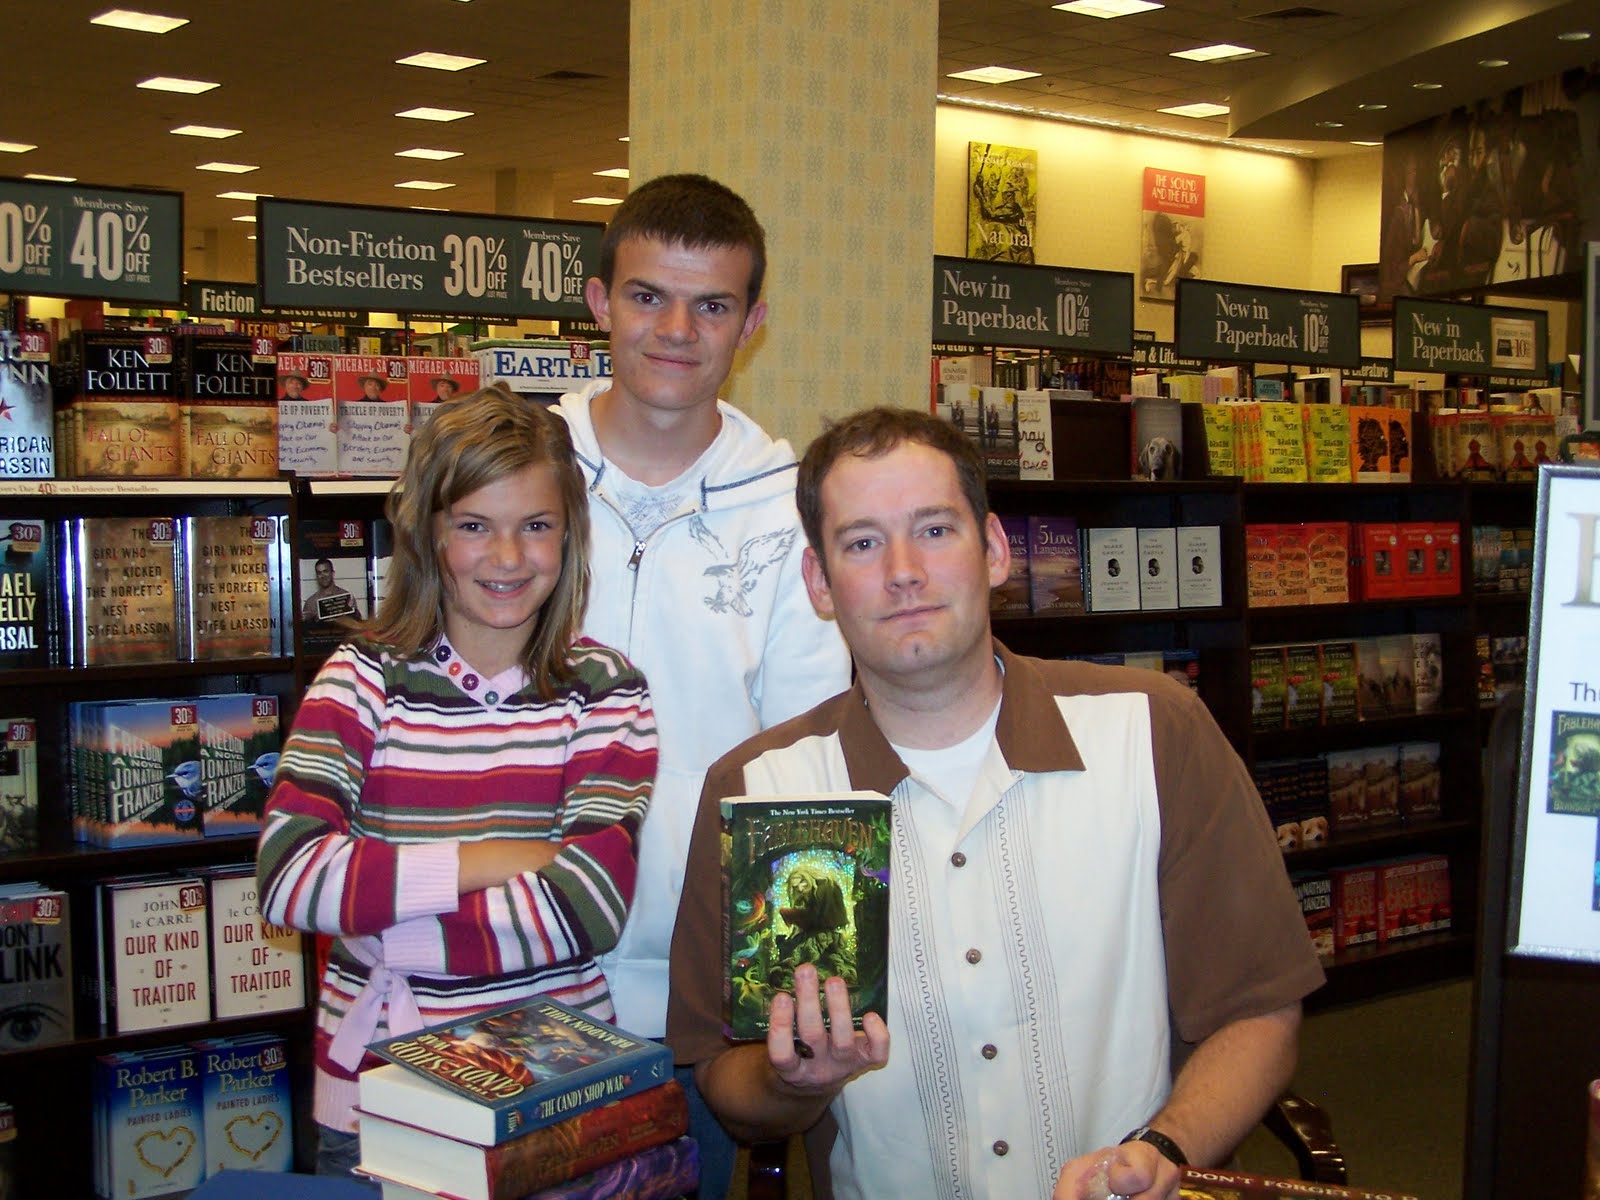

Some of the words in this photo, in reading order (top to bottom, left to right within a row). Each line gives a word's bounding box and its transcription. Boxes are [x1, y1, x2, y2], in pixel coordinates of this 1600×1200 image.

[1170, 176, 1196, 192] SOUND
[73, 196, 122, 211] Members
[124, 201, 150, 214] Save
[70, 210, 151, 281] 40%
[286, 226, 437, 263] Non-Fiction
[522, 229, 561, 241] Members
[562, 232, 581, 243] Save
[25, 243, 52, 266] OFF
[124, 251, 151, 274] OFF
[443, 234, 508, 298] 30%
[286, 257, 424, 292] Bestsellers
[486, 271, 508, 291] OFF
[521, 241, 583, 303] 40%
[563, 276, 583, 295] OFF
[942, 269, 989, 298] New
[990, 275, 1012, 300] in
[201, 287, 255, 314] Fiction
[1215, 293, 1250, 319] New
[1252, 298, 1270, 320] in
[942, 299, 1050, 337] Paperback
[1076, 318, 1090, 332] OFF
[1412, 312, 1442, 336] New
[1445, 316, 1461, 338] in
[1215, 320, 1299, 354] Paperback
[108, 348, 150, 369] KEN
[215, 352, 256, 373] KEN
[1412, 336, 1486, 368] Paperback
[335, 359, 375, 373] MICHAEL
[408, 359, 448, 374] MICHAEL
[449, 360, 480, 376] SAVAGE
[493, 350, 592, 379] EARTH
[87, 369, 172, 391] FOLLETT
[194, 373, 274, 395] FOLLETT
[301, 405, 330, 416] POVERTY
[368, 406, 377, 416] UP
[378, 406, 404, 417] POVERTY
[87, 428, 121, 443] FALL
[128, 428, 150, 443] OF
[197, 431, 229, 446] FALL
[236, 432, 254, 447] OF
[105, 444, 176, 463] GIANTS
[211, 448, 275, 466] GIANTS
[117, 485, 160, 493] Bestsellers
[1039, 524, 1049, 545] 5
[1050, 531, 1073, 545] Love
[122, 545, 147, 559] WHO
[202, 545, 225, 557] GIRL
[230, 544, 253, 557] WHO
[1033, 544, 1077, 556] Languages
[124, 566, 162, 578] KICKED
[231, 562, 269, 575] KICKED
[111, 584, 163, 598] HORNET'S
[196, 583, 215, 595] THE
[219, 581, 269, 595] HORNET'S
[103, 604, 129, 617] NEST
[211, 600, 236, 612] NEST
[123, 622, 170, 636] LARSSON
[230, 618, 277, 631] LARSSON
[112, 757, 127, 766] A
[131, 759, 163, 769] NOVEL
[215, 751, 245, 761] NOVEL
[111, 766, 164, 791] JONATHAN
[111, 782, 165, 824] FRANZEN
[828, 807, 855, 815] Bestseller
[745, 816, 875, 865] FABLEHAVEN
[143, 899, 180, 913] JOHN
[125, 935, 157, 957] OUR
[164, 929, 200, 952] KIND
[223, 923, 255, 945] OUR
[251, 946, 270, 967] OF
[154, 959, 174, 980] OF
[230, 969, 292, 994] TRAITOR
[132, 982, 197, 1008] TRAITOR
[416, 1034, 452, 1051] WAR
[207, 1050, 262, 1074] Robert
[389, 1041, 442, 1071] SHOP
[116, 1066, 177, 1089] Robert
[179, 1058, 200, 1080] B.
[219, 1071, 276, 1094] Parker
[450, 1065, 525, 1098] CANDY
[129, 1085, 189, 1109] Parker
[539, 1101, 556, 1120] THE
[556, 1089, 584, 1112] CANDY
[584, 1082, 605, 1103] SHOP
[606, 1074, 625, 1095] WAR
[127, 1112, 162, 1127] PAINTED
[164, 1107, 193, 1122] LADIES
[1186, 1169, 1254, 1184] DON'T
[1263, 1179, 1351, 1199] FORGET
